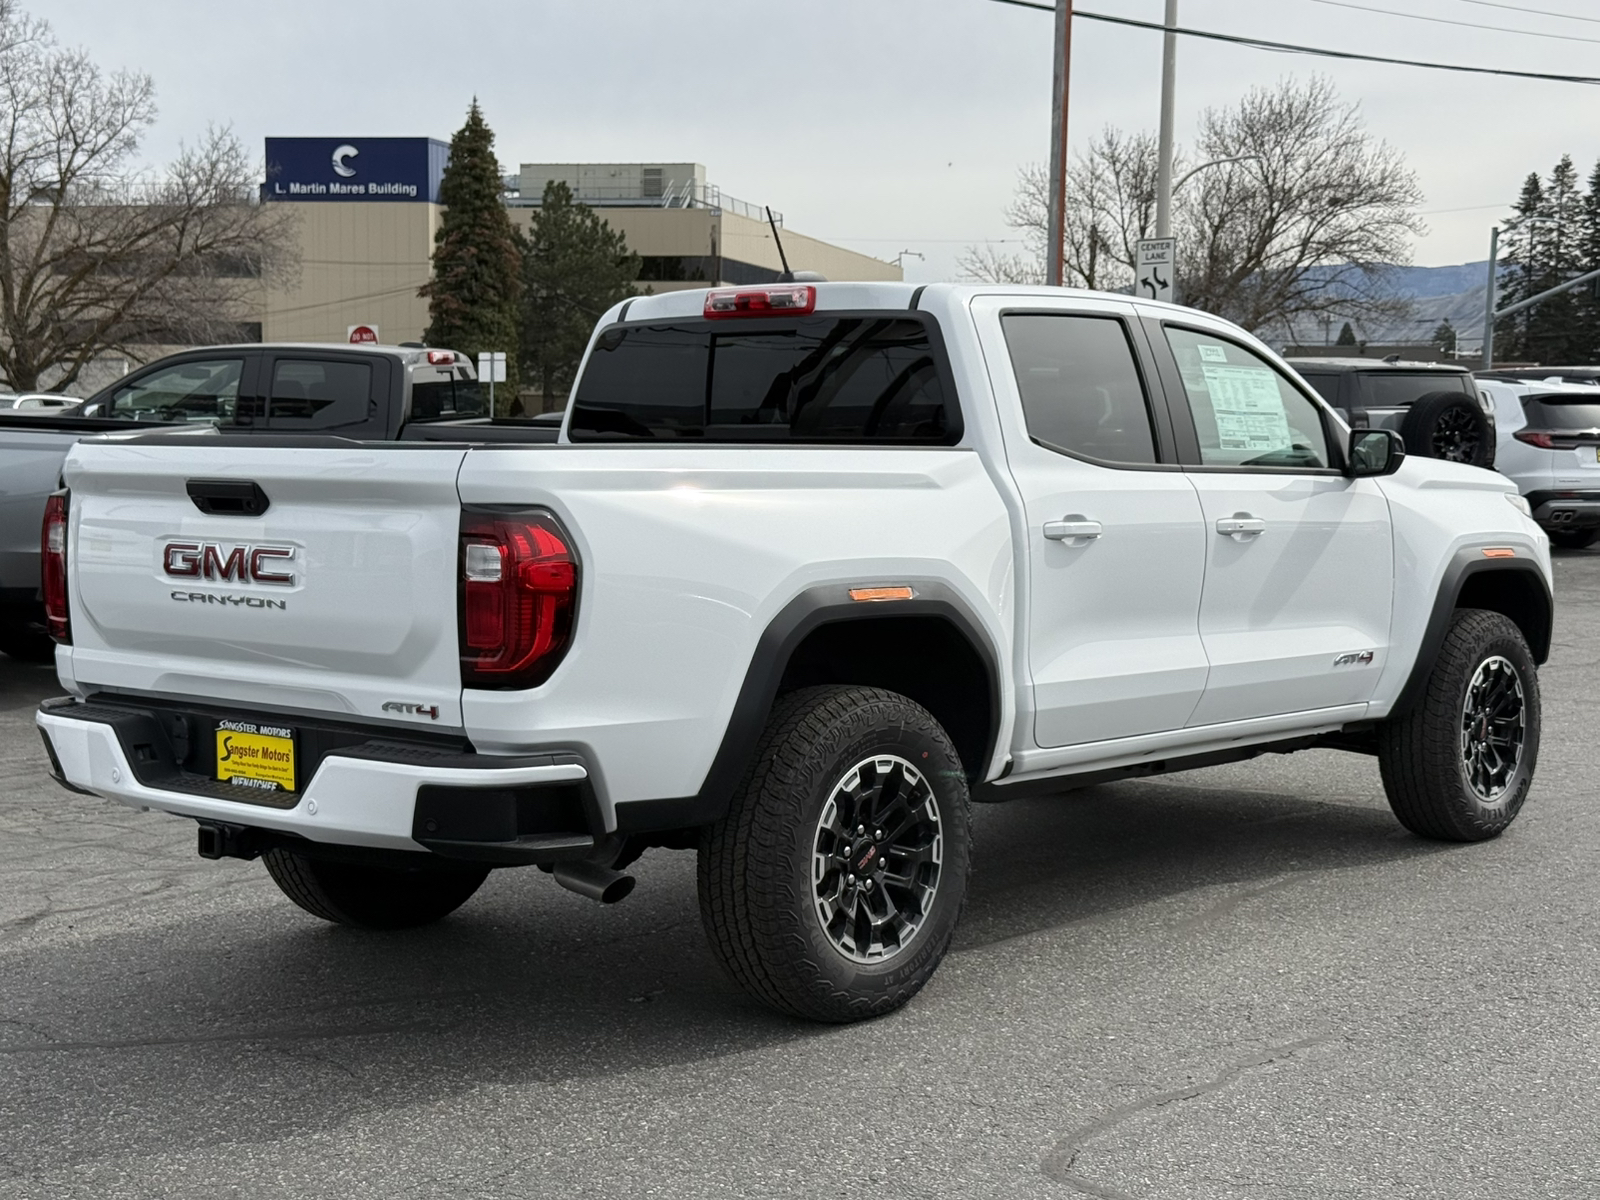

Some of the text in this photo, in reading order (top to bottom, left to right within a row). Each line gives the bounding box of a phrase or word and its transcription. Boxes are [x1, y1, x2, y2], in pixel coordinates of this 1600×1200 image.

[275, 182, 418, 197] L. Martin Mares Building
[1141, 242, 1171, 251] CENTER
[1145, 252, 1166, 261] LANE
[352, 333, 373, 341] DO NOT
[163, 540, 297, 587] GMC
[170, 590, 287, 611] CANYON
[1333, 649, 1374, 666] AT4
[381, 701, 440, 720] AT4
[215, 720, 292, 739] SANGSTER MOTORS
[220, 735, 291, 763] Sangster Motors
